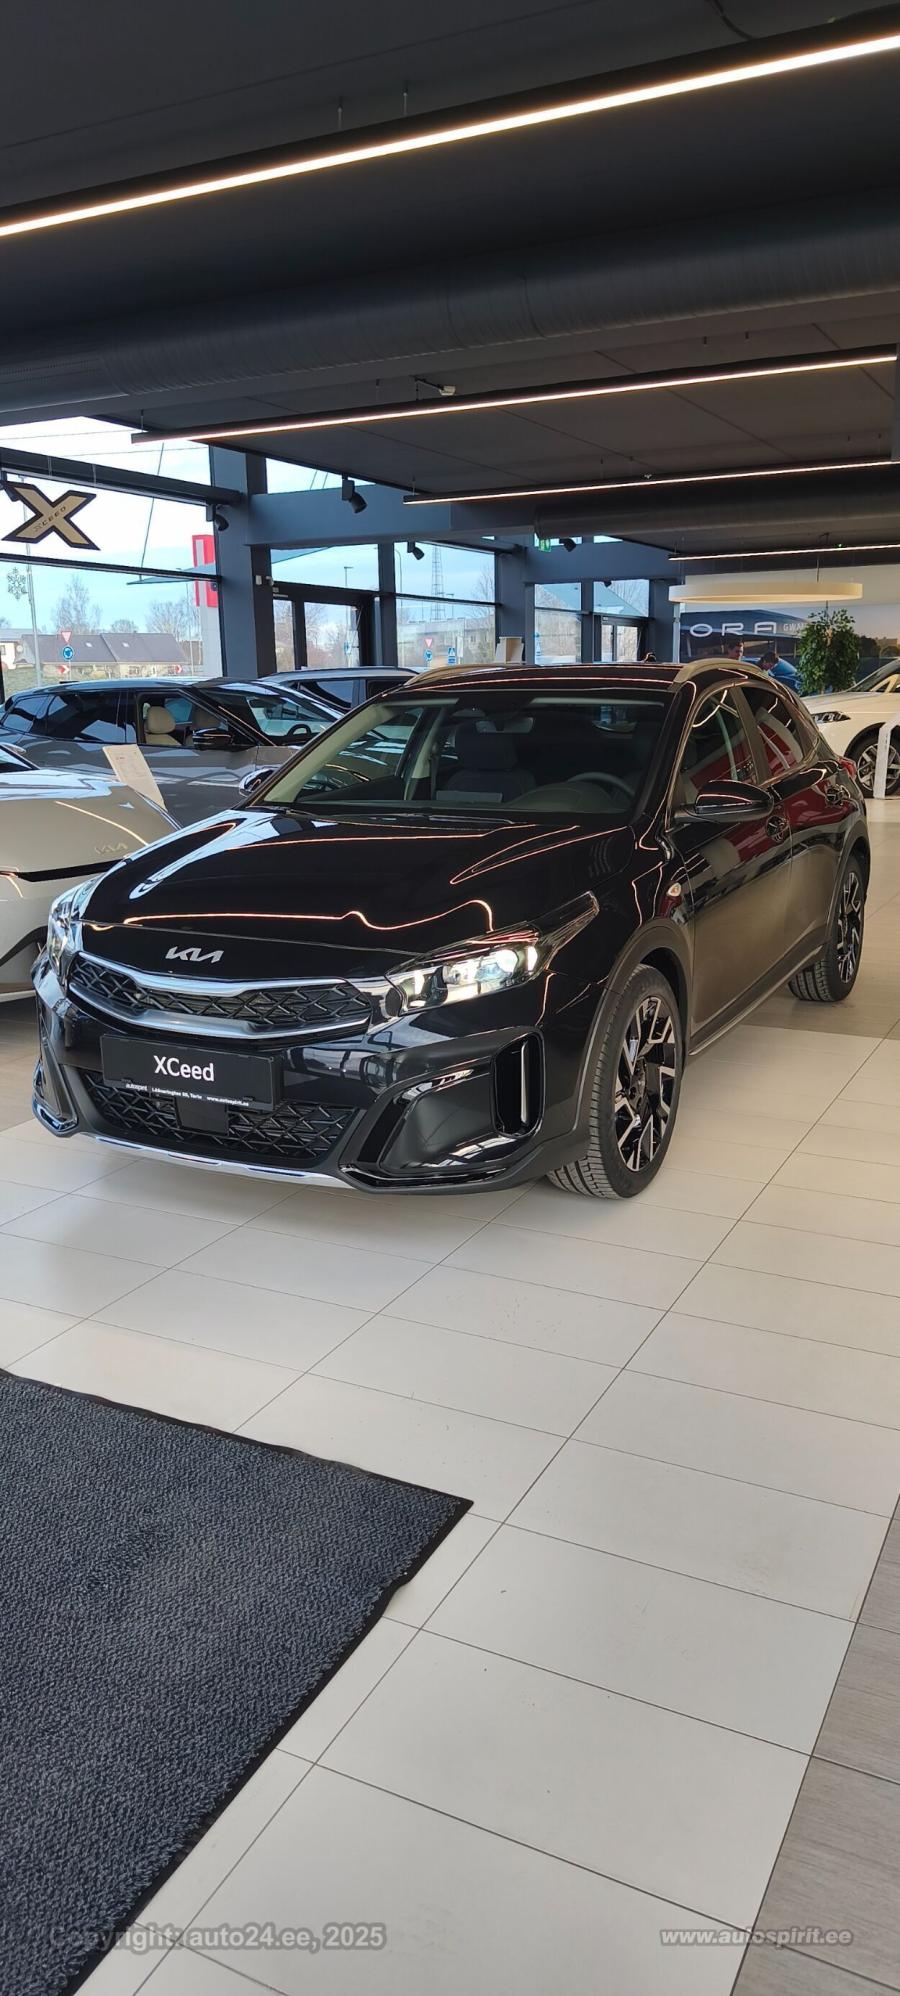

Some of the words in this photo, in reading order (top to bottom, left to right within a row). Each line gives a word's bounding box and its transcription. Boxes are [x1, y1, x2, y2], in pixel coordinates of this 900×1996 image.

[690, 621, 777, 637] ORA
[165, 946, 225, 963] KIA
[153, 1055, 215, 1082] XCeed
